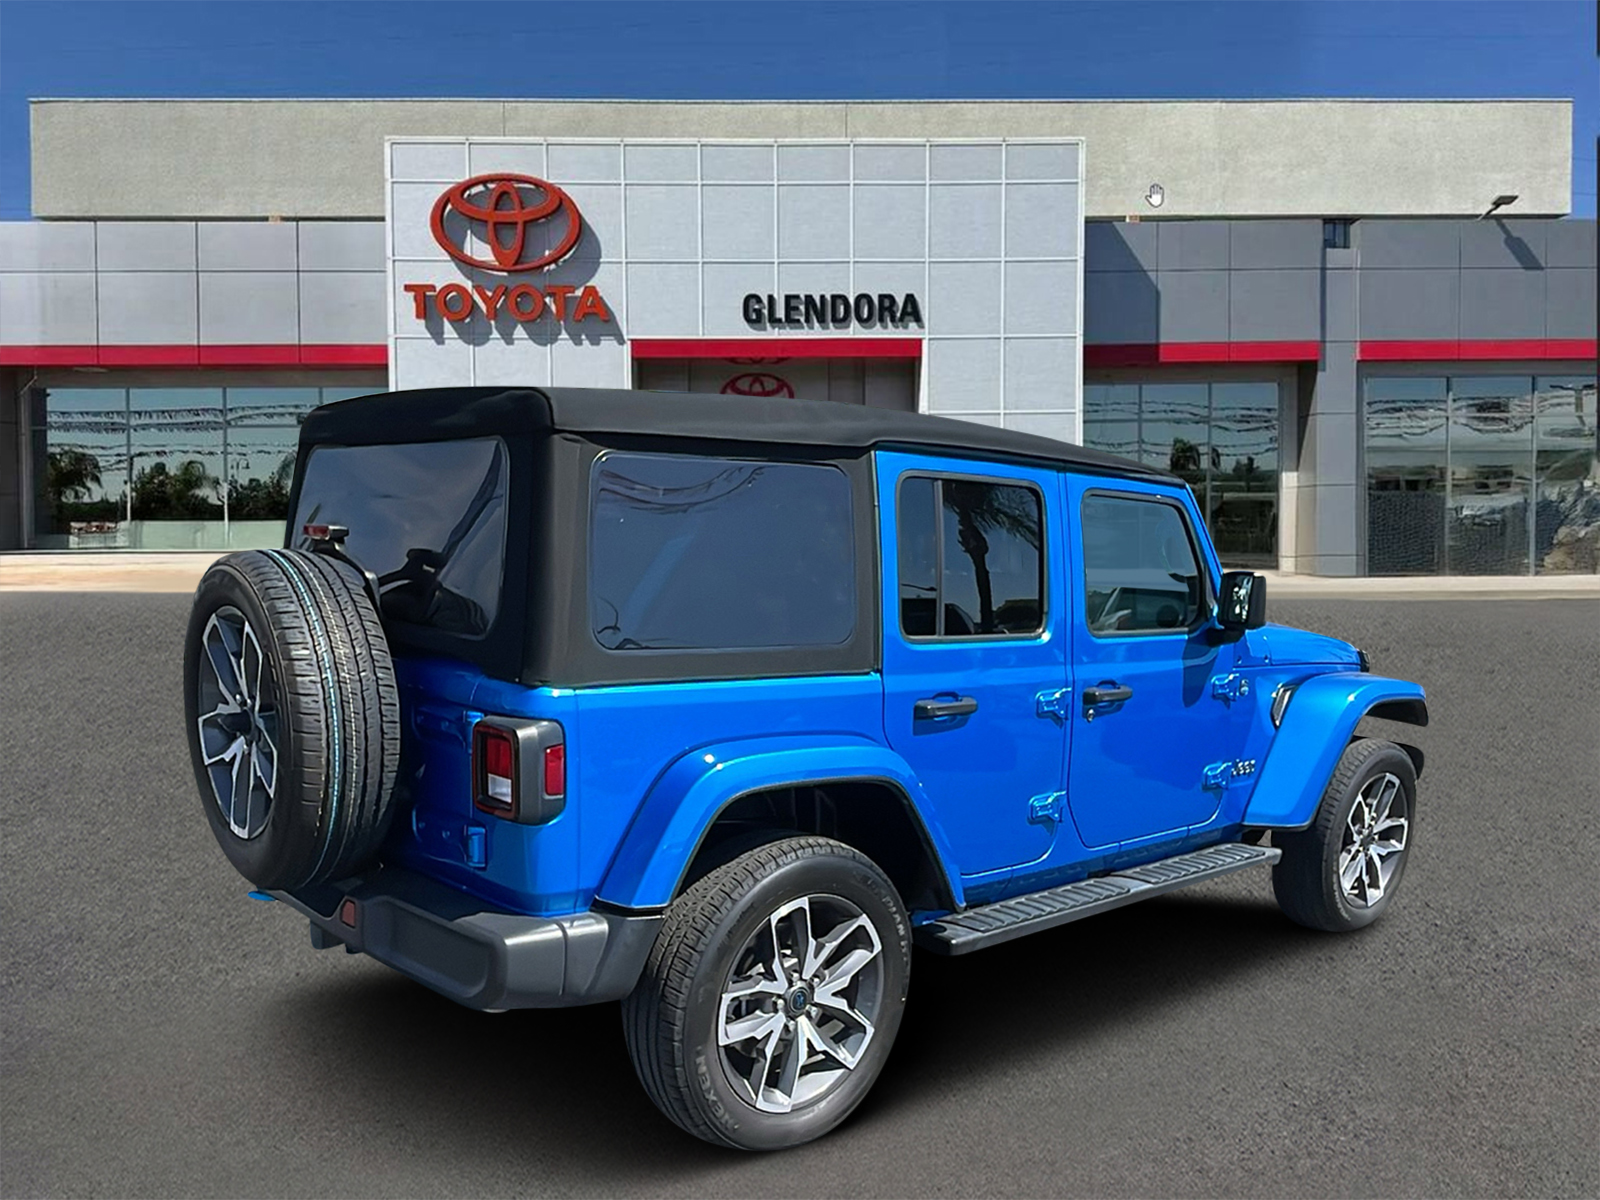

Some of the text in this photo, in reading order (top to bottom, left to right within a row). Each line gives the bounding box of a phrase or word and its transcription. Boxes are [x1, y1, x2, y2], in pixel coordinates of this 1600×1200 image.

[404, 283, 610, 323] TOYOTA
[742, 293, 922, 326] GLENDORA
[696, 1055, 732, 1129] NEXEN
